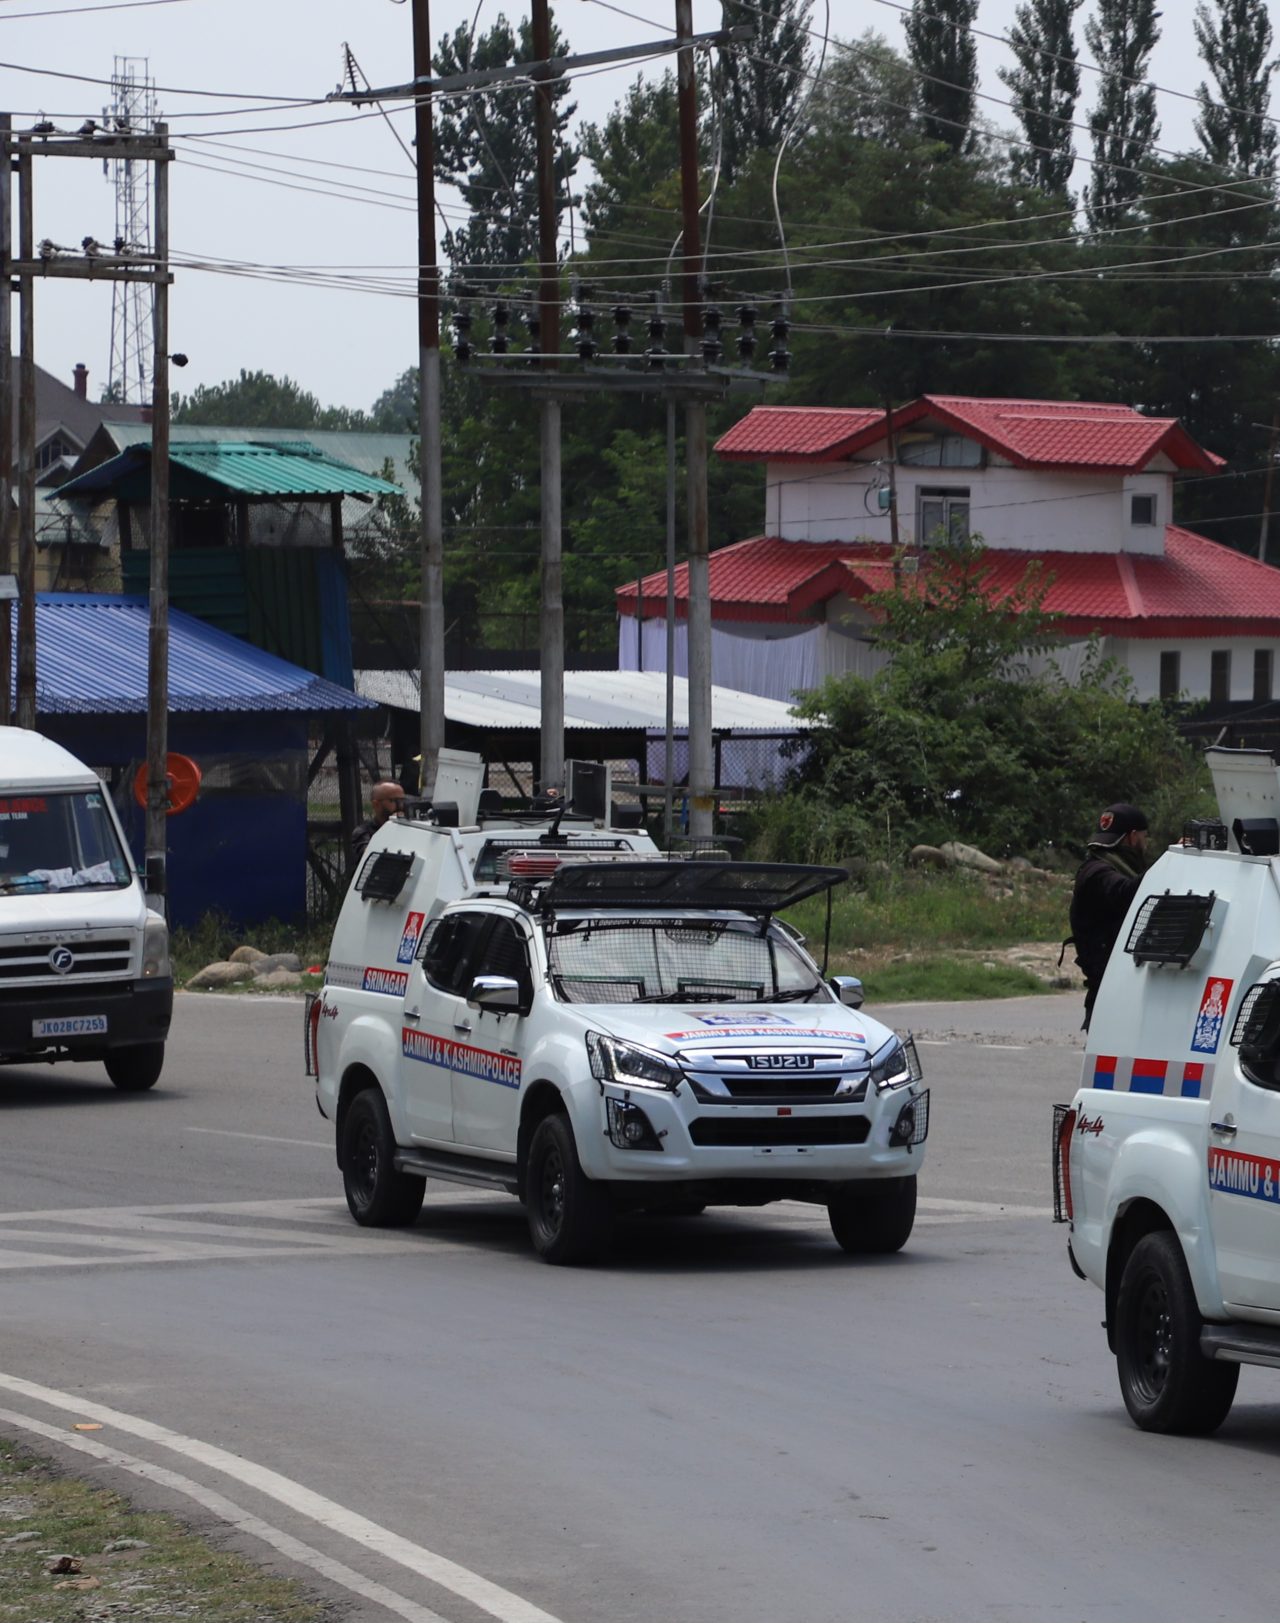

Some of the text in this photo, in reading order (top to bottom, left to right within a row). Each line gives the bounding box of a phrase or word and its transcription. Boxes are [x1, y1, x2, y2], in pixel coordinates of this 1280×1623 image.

[365, 969, 408, 996] SRINAGAR
[403, 1031, 435, 1060] JAMMU
[435, 1040, 442, 1063] &
[680, 1028, 861, 1041] JAMMU AND KASHMIR POLICE
[750, 1056, 810, 1068] ISUZU
[1210, 1153, 1260, 1194] JAMMU
[1263, 1165, 1274, 1198] &
